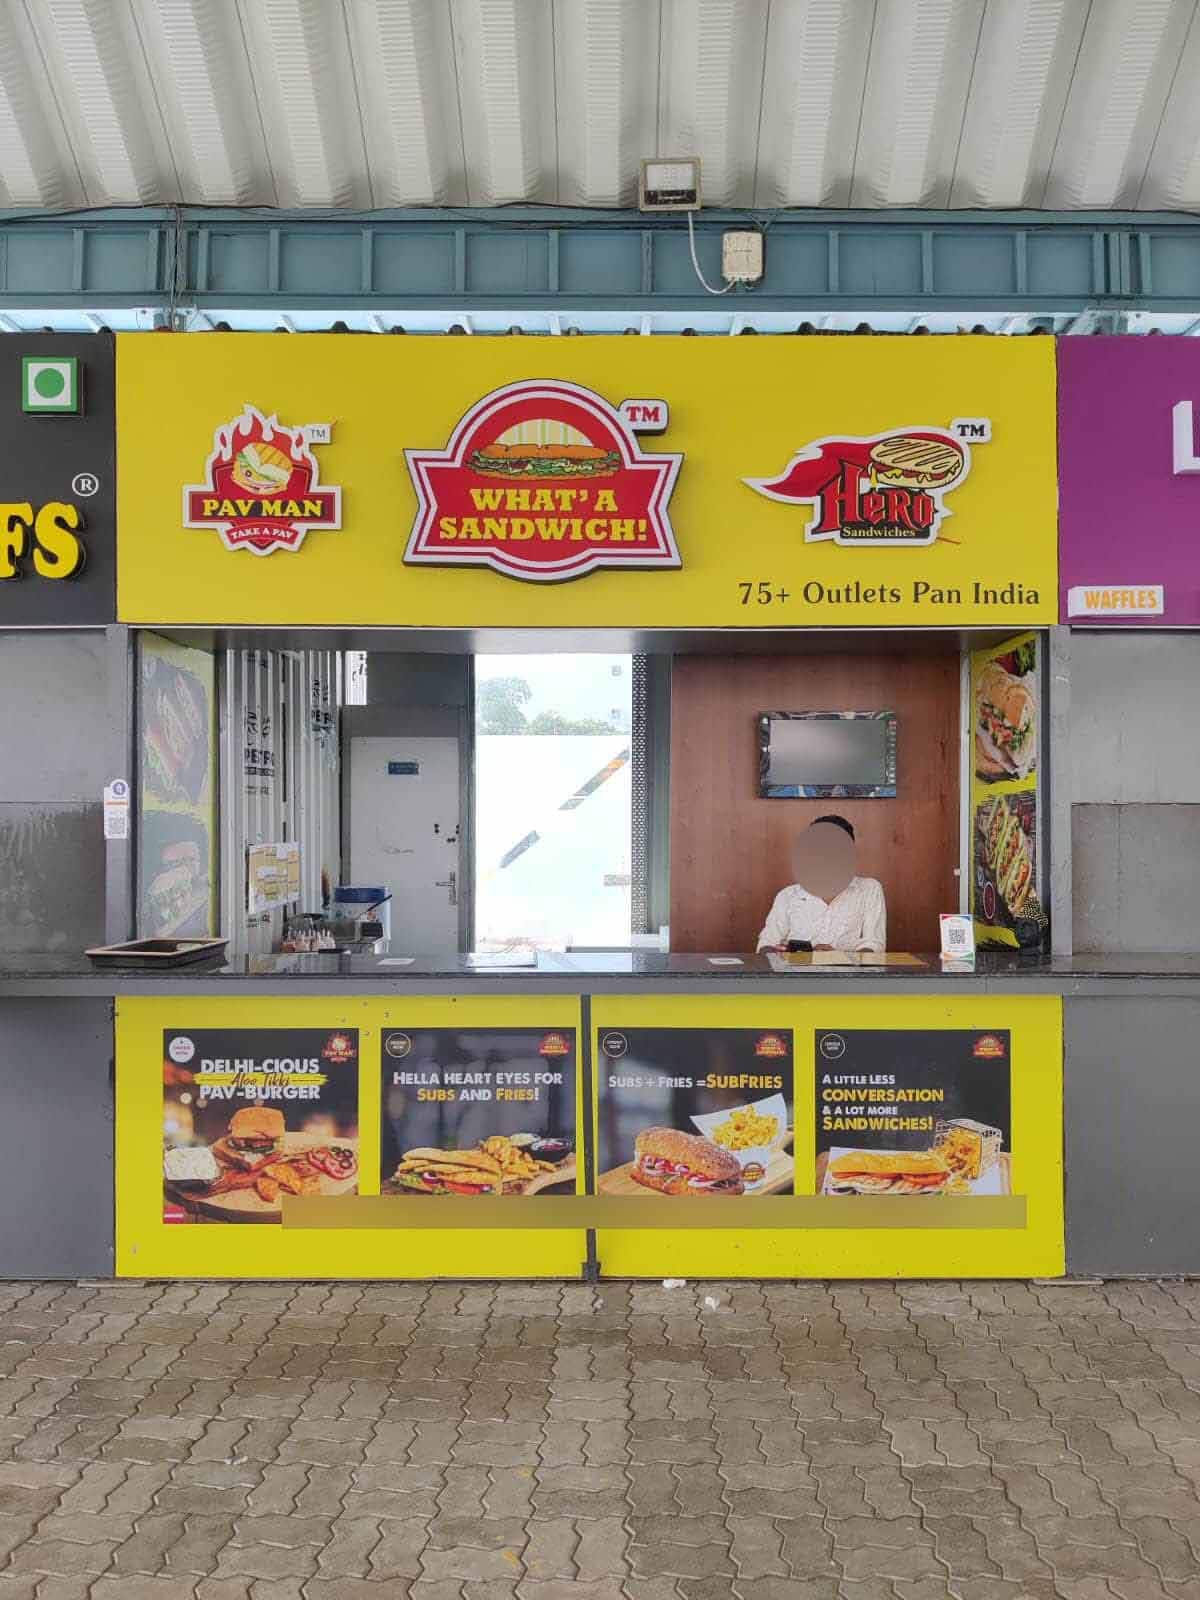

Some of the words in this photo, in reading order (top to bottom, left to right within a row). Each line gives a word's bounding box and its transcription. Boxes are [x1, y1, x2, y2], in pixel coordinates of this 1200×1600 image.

[626, 406, 660, 422] TM
[957, 424, 985, 437] TM
[203, 499, 256, 516] PAV
[261, 499, 323, 517] MAN
[231, 527, 261, 540] TAKE
[439, 517, 648, 542] SANDWICH!
[842, 527, 916, 538] Sandwiches
[738, 581, 791, 604] 75+
[803, 581, 901, 604] Outlets
[912, 581, 961, 604] Pan
[973, 582, 1040, 605] India
[1084, 591, 1157, 608] WAFFLES
[200, 1058, 320, 1074] DELHI-CIOUS
[393, 1071, 440, 1085] HELLA
[444, 1072, 491, 1085] HEART
[496, 1072, 531, 1085] EYES
[534, 1072, 563, 1085] FOR
[822, 1074, 832, 1084] A
[834, 1075, 867, 1084] LITTLE
[869, 1074, 896, 1084] LESS
[199, 1086, 321, 1100] PAV-BURGER
[417, 1088, 456, 1101] SUBS
[459, 1088, 492, 1101] AND
[496, 1087, 540, 1101] FRIES!
[822, 1088, 944, 1102] CONVERSATION
[834, 1106, 842, 1115] A
[845, 1106, 865, 1115] LOT
[867, 1106, 898, 1115] MORE
[822, 1116, 933, 1131] SANDWICHES!
